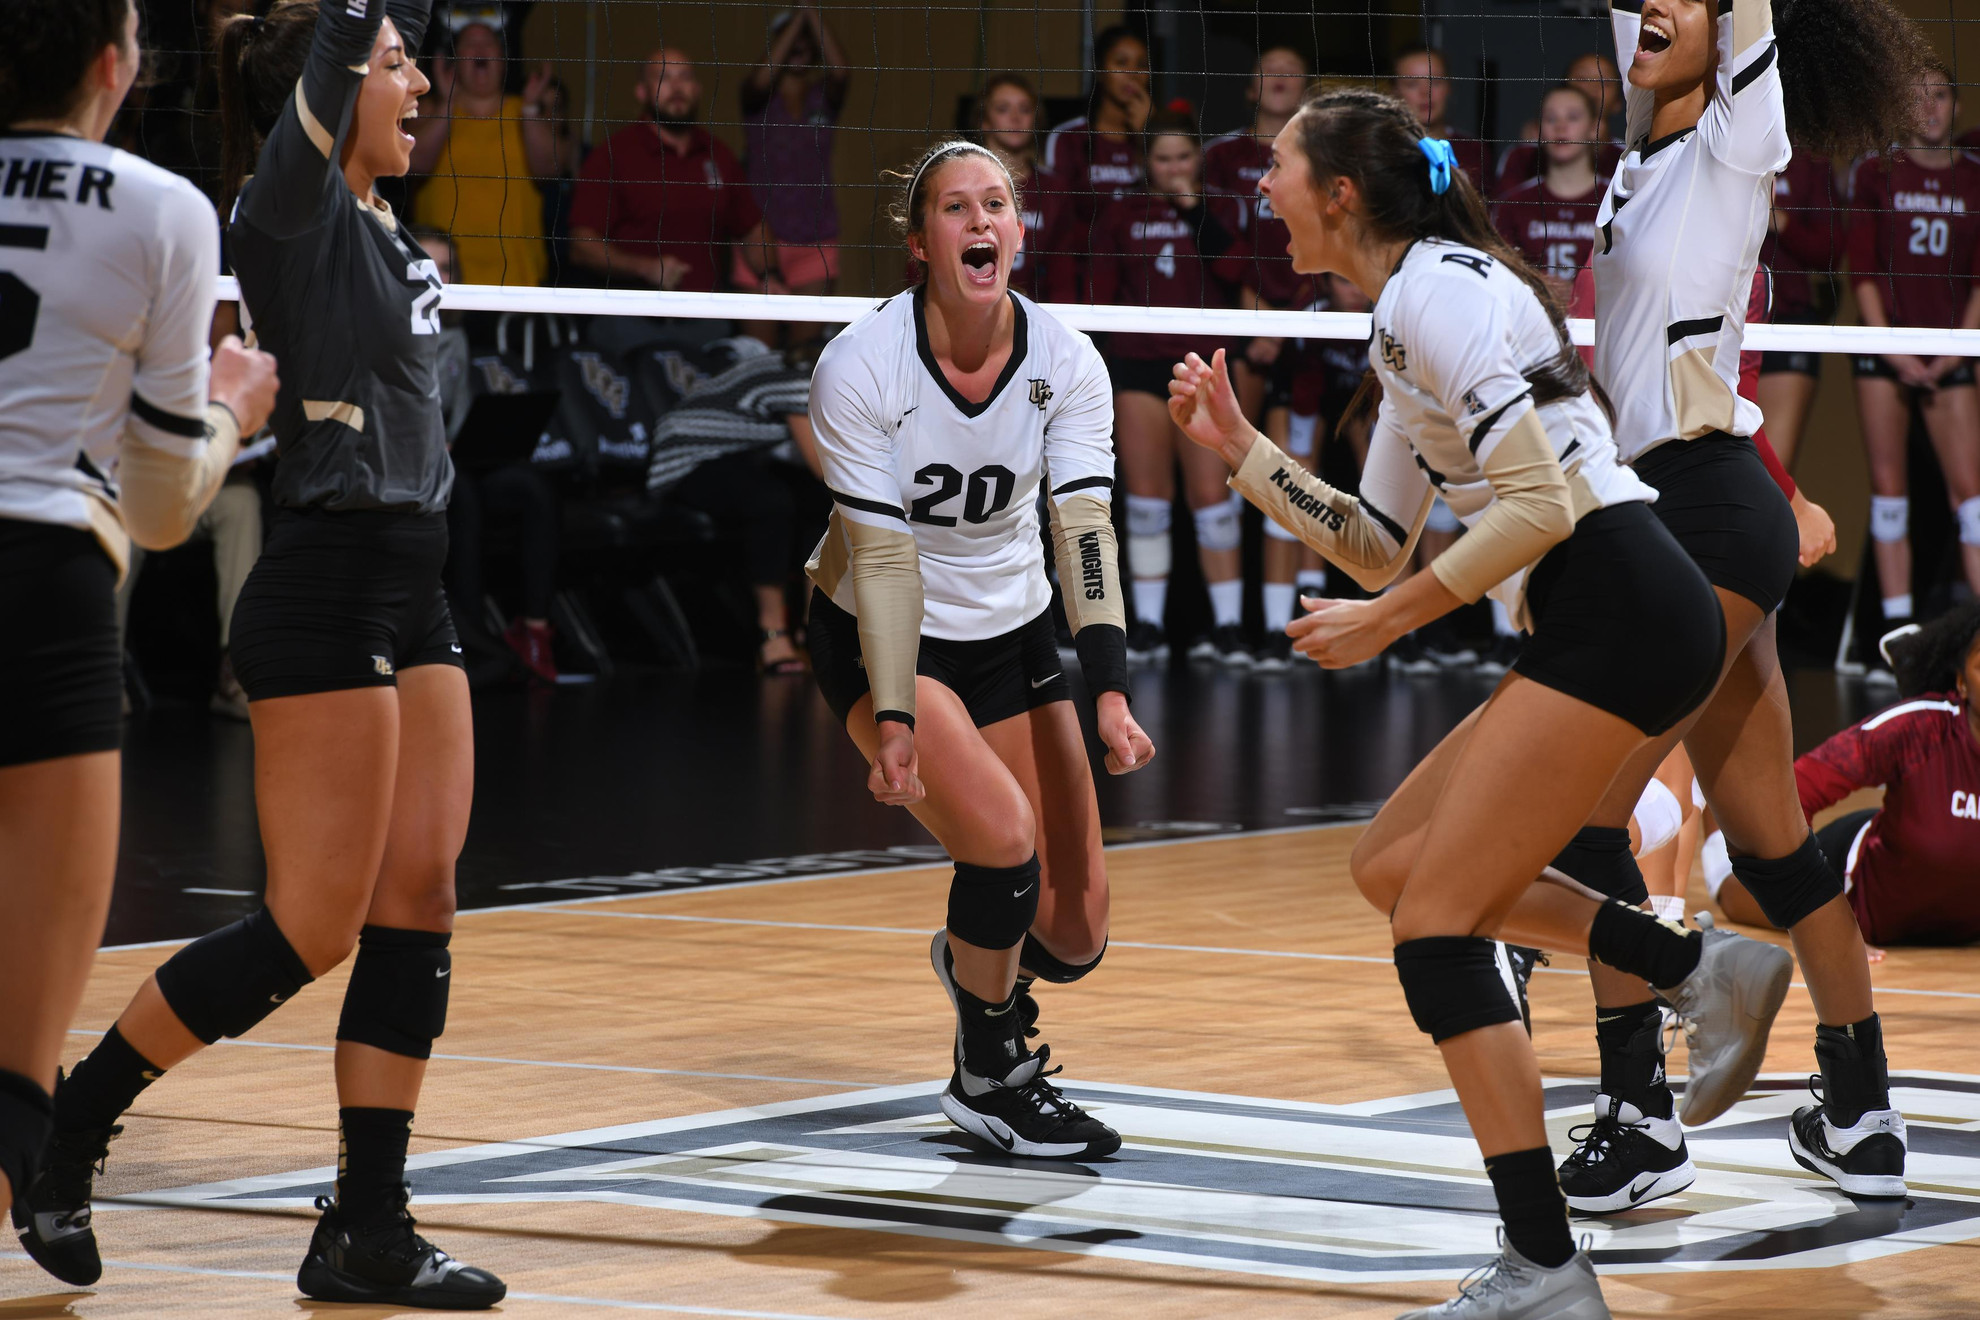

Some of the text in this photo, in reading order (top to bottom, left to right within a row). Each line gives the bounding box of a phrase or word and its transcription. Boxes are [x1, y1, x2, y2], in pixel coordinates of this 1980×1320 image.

[0, 156, 115, 212] HER
[1893, 191, 1966, 216] CAROLINA
[1528, 219, 1595, 240] CAROLIN
[1908, 216, 1949, 256] 20
[1155, 242, 1176, 279] 4
[1546, 242, 1578, 281] 15
[910, 462, 1016, 528] 20
[1269, 466, 1346, 532] KNIGHTS
[1077, 530, 1106, 601] KNIGHTS
[1951, 789, 1980, 821] CA
